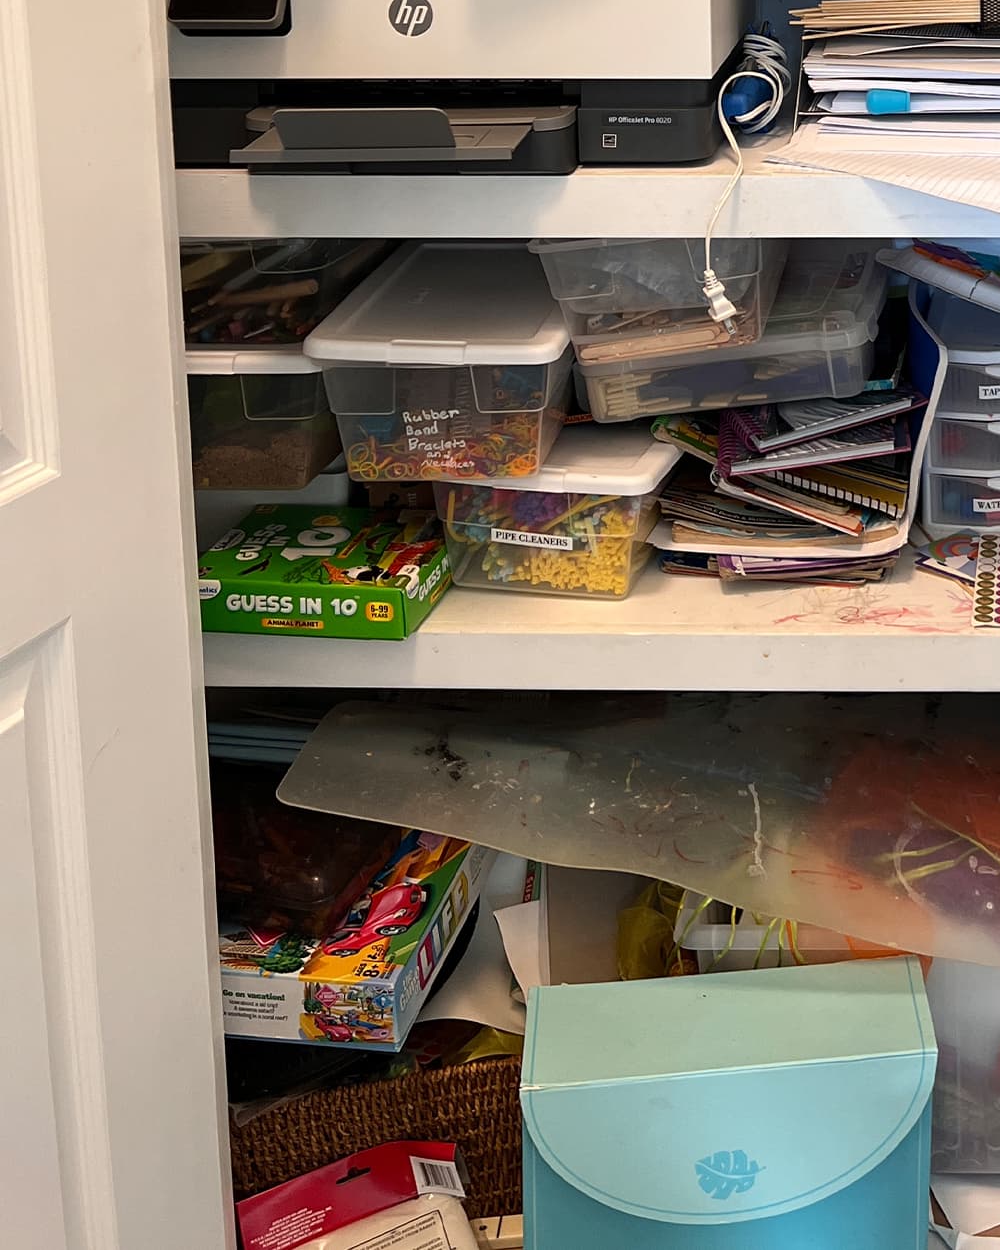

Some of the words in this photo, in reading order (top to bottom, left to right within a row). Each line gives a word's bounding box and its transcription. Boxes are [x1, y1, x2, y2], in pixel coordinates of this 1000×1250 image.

[644, 116, 656, 124] Pro
[402, 408, 460, 423] Rubber
[405, 420, 438, 437] Band
[235, 523, 289, 561] GUESS
[269, 533, 291, 547] IN
[279, 526, 351, 562] 10
[495, 530, 517, 541] PIPE
[518, 533, 568, 547] CLEANERS
[225, 593, 294, 614] GUESS
[299, 596, 322, 615] IN
[330, 598, 358, 616] 10
[370, 604, 389, 613] 6-99
[266, 619, 295, 627] ANIMAL
[417, 869, 469, 991] LIFE
[222, 989, 234, 997] Go
[247, 992, 285, 1001] vacation!
